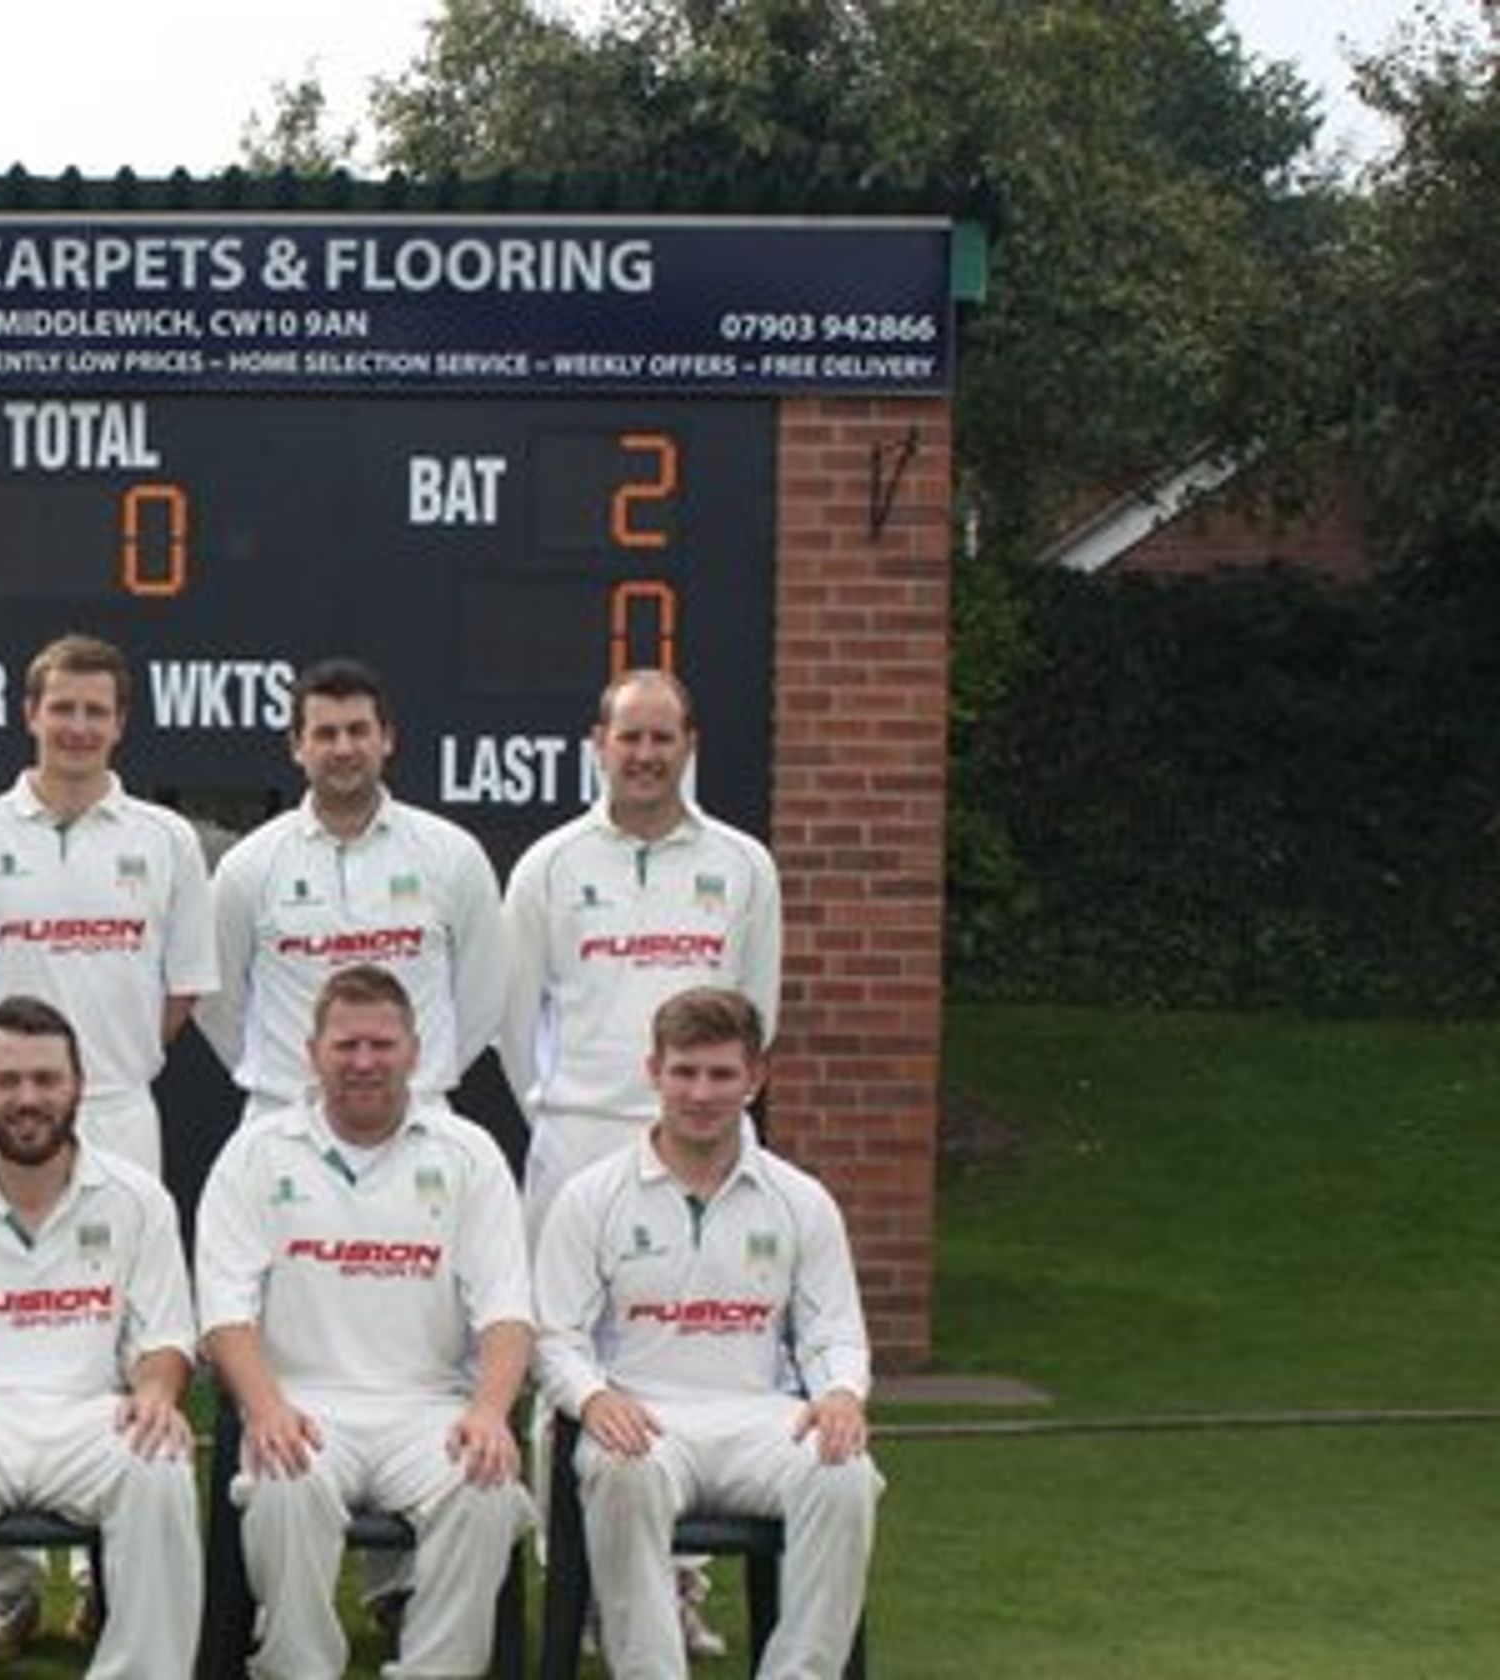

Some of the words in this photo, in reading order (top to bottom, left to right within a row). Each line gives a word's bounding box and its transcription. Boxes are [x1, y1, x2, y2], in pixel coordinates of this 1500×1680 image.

[261, 238, 308, 291] &
[325, 238, 654, 293] FLOORING
[209, 310, 298, 338] CW10
[304, 310, 368, 338] 9AN
[721, 314, 815, 341] 07903
[822, 314, 936, 341] 942866
[66, 351, 121, 373] LOW
[125, 351, 204, 373] PRICES
[229, 351, 298, 373] HOME
[304, 351, 431, 374] SELECTION
[435, 353, 528, 375] SERVICE
[554, 354, 646, 376] WEEKLY
[649, 354, 737, 376] OFFERS
[761, 355, 816, 377] FREE
[821, 355, 934, 378] DELIVERY
[5, 403, 161, 469] TOTAL
[408, 457, 507, 524] BAT
[611, 434, 677, 547] 2
[122, 484, 187, 596] 0
[150, 660, 296, 729] WKTS
[440, 735, 567, 804] LAST
[287, 1237, 442, 1266] FUSION
